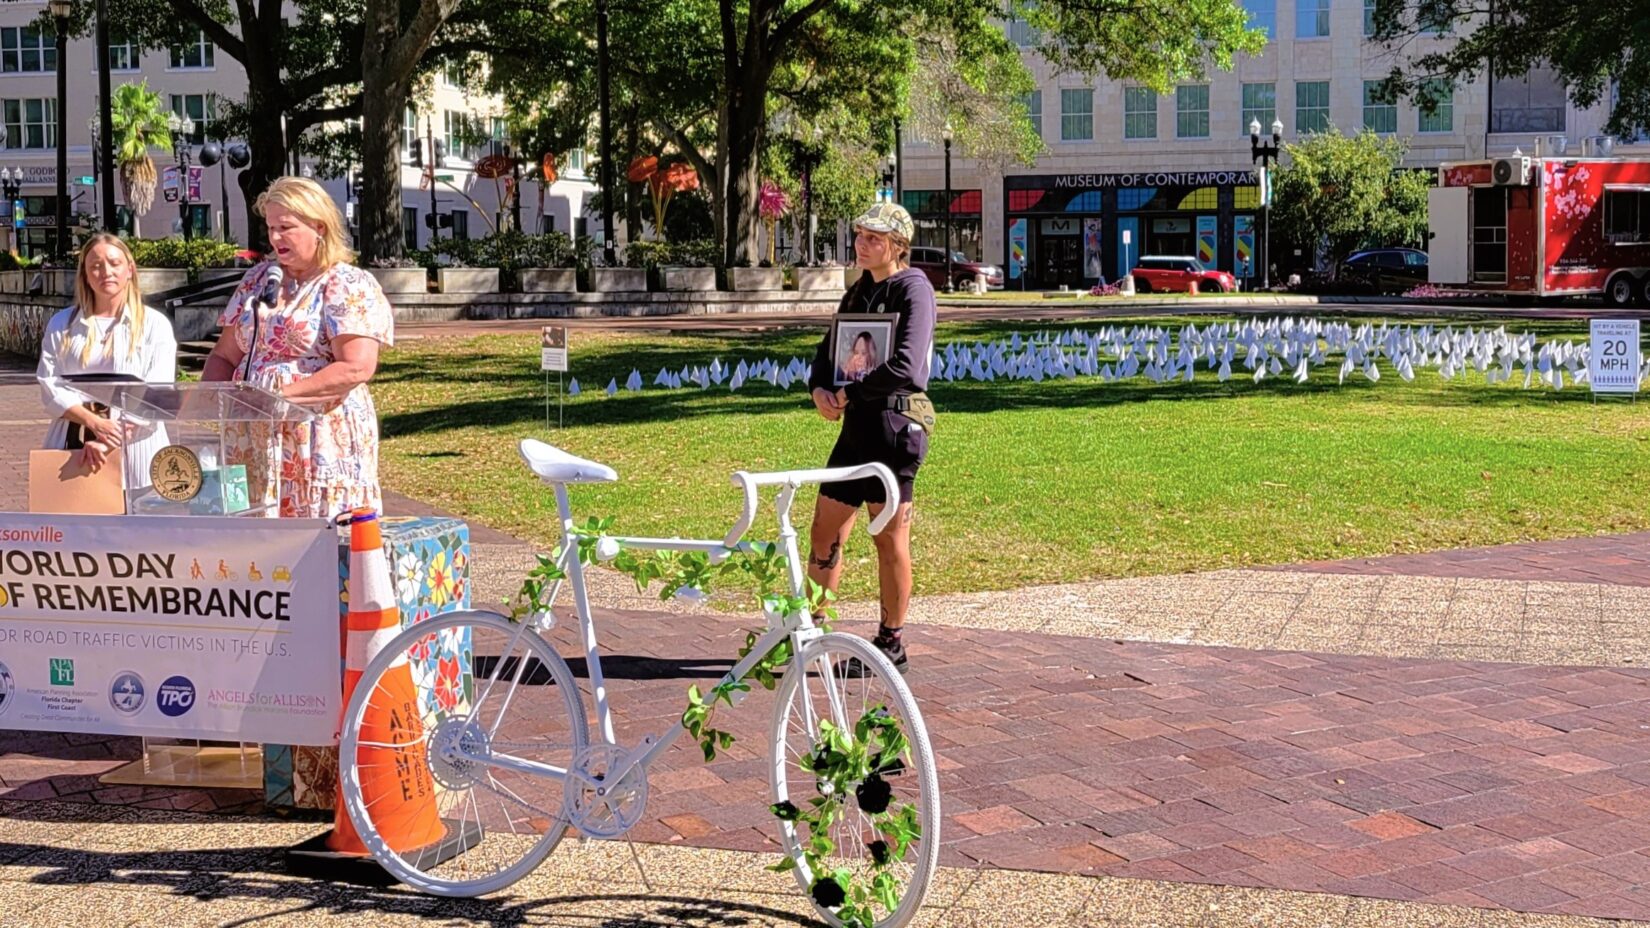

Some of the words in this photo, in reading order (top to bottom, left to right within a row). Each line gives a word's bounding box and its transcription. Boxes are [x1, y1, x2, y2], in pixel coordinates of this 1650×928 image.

[30, 167, 71, 176] GODBOD
[1055, 175, 1117, 188] MUSEUM
[1121, 173, 1141, 187] OF
[1145, 171, 1257, 187] CONTEMPORAR
[1052, 220, 1070, 231] M
[1603, 340, 1627, 356] 20
[1600, 358, 1629, 371] MPH
[106, 552, 176, 579] DAY
[32, 583, 291, 621] REMEMBRANCE
[0, 629, 18, 642] OR
[23, 630, 67, 645] ROAD
[73, 632, 136, 648] TRAFFIC
[140, 634, 205, 652] VICTIMS
[211, 638, 225, 653] IN
[231, 639, 260, 655] THE
[264, 642, 292, 657] U.S.
[50, 659, 74, 671] APA
[41, 695, 60, 703] Florida
[161, 690, 193, 707] TPO
[389, 708, 413, 802] ACME
